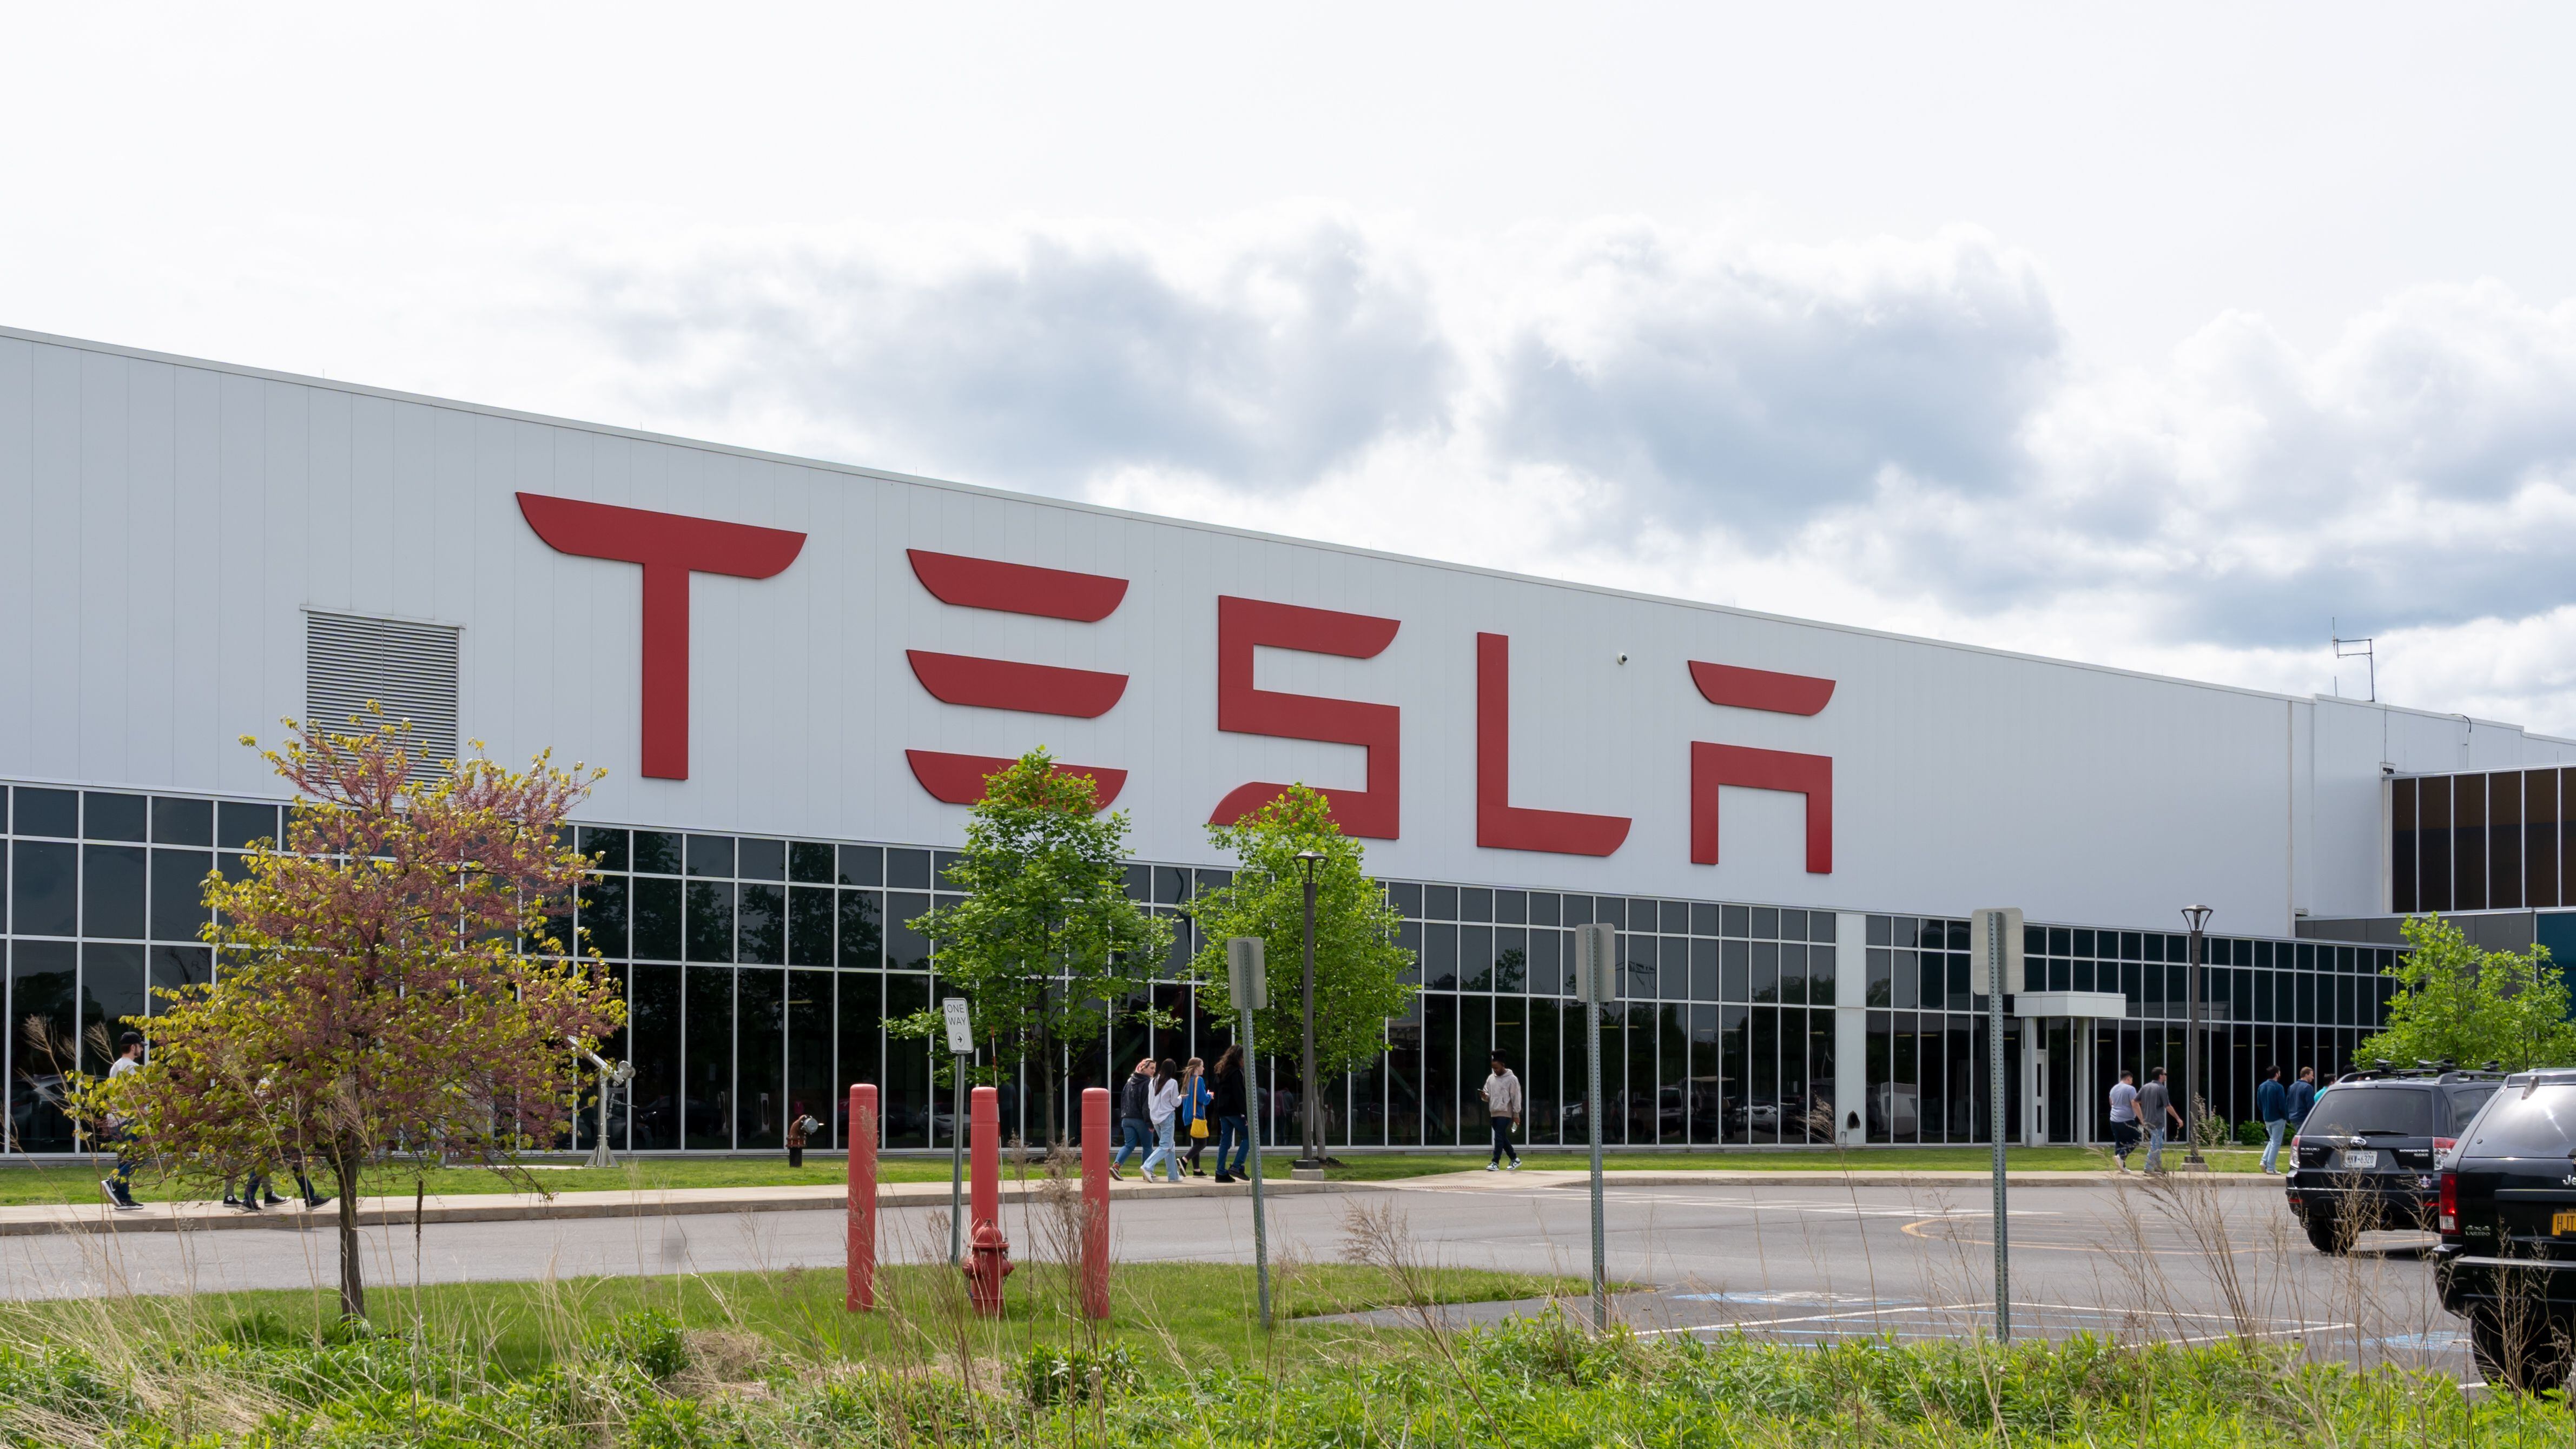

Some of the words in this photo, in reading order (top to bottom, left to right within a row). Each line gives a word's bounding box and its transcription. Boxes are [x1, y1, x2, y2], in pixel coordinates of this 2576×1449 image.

[516, 492, 1836, 874] TESLA
[947, 1004, 965, 1013] ONE
[948, 1017, 966, 1025] WAY
